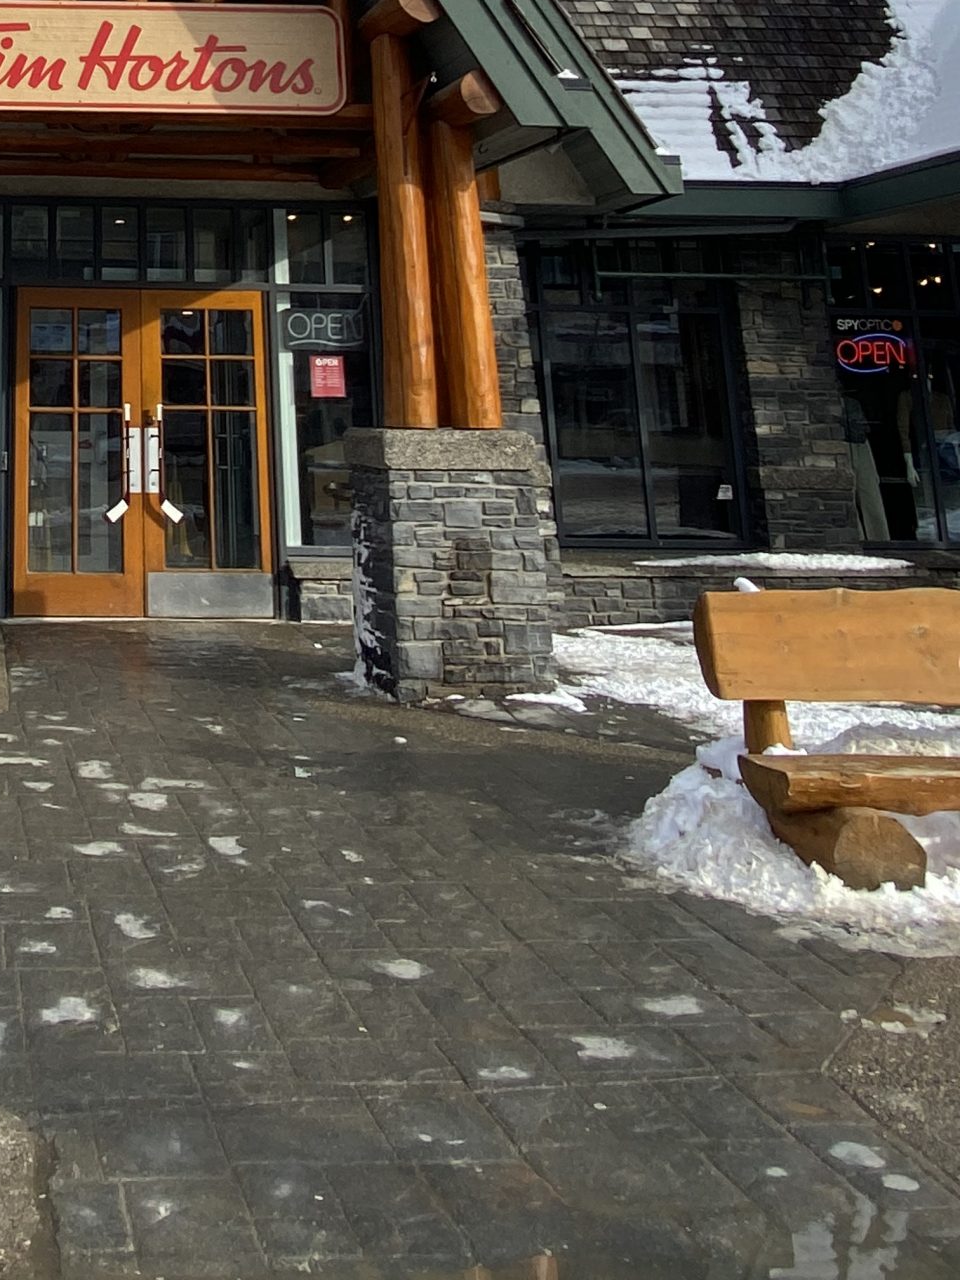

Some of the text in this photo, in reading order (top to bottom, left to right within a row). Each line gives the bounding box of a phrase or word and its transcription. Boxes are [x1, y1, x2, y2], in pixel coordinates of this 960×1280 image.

[77, 20, 315, 95] Hortons
[287, 312, 364, 339] OPEN
[837, 340, 905, 364] OPEN
